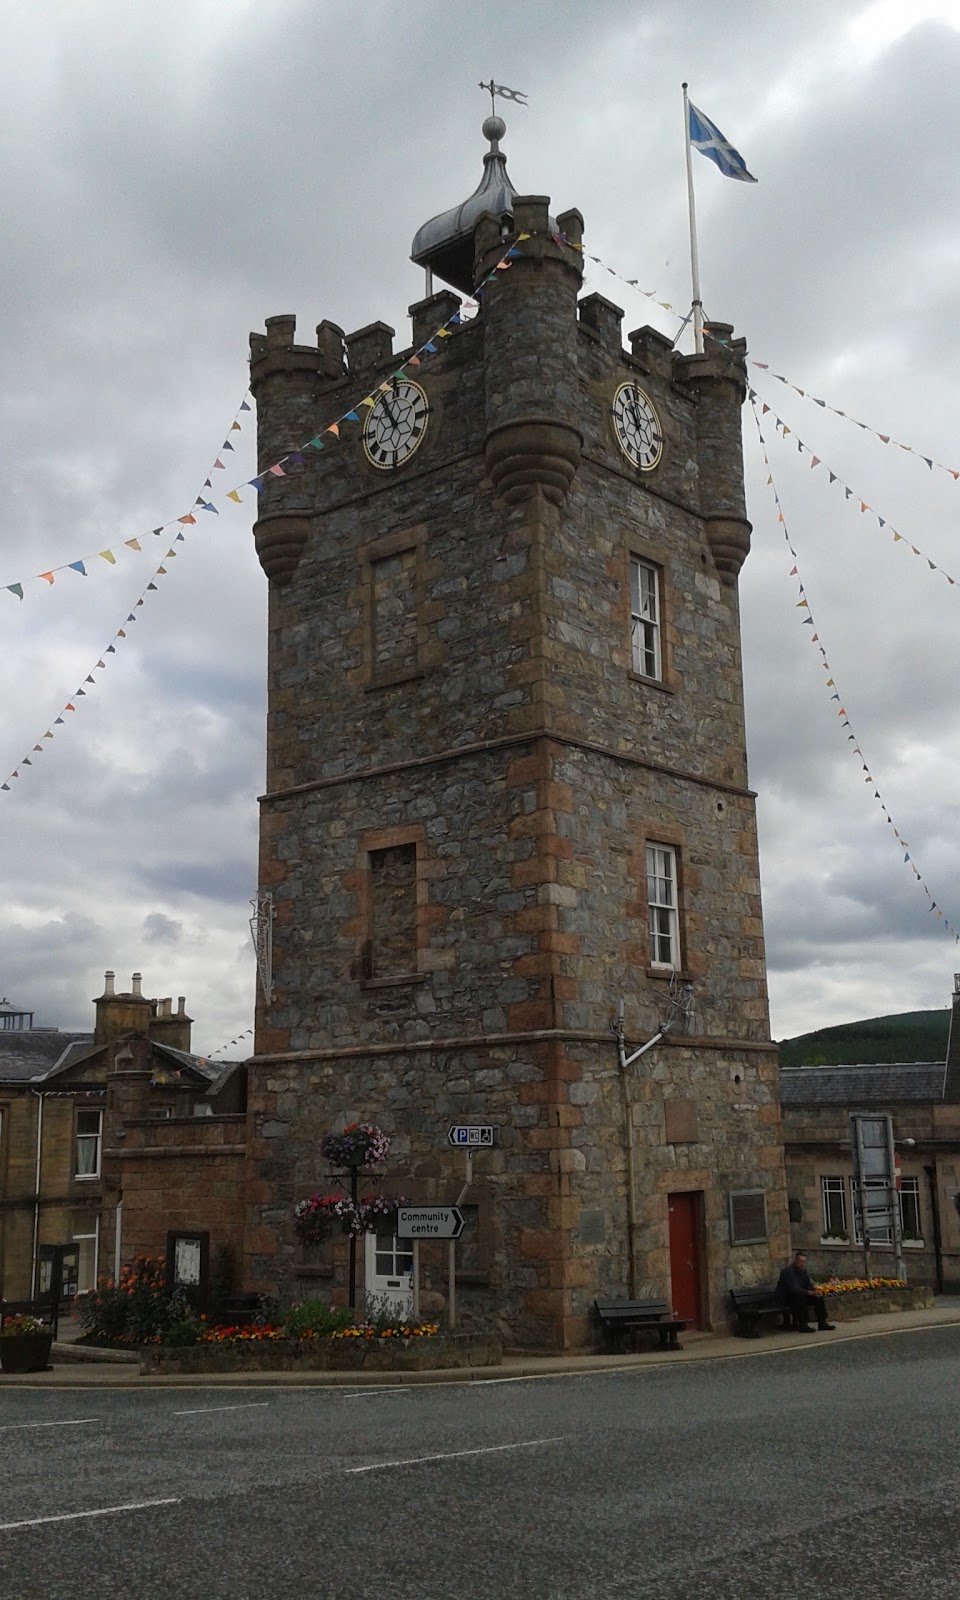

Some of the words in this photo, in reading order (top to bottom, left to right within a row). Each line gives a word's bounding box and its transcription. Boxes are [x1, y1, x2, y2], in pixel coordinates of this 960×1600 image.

[460, 1130, 467, 1141] P
[470, 1131, 479, 1140] WC
[401, 1211, 449, 1223] Community
[411, 1224, 439, 1233] centre
